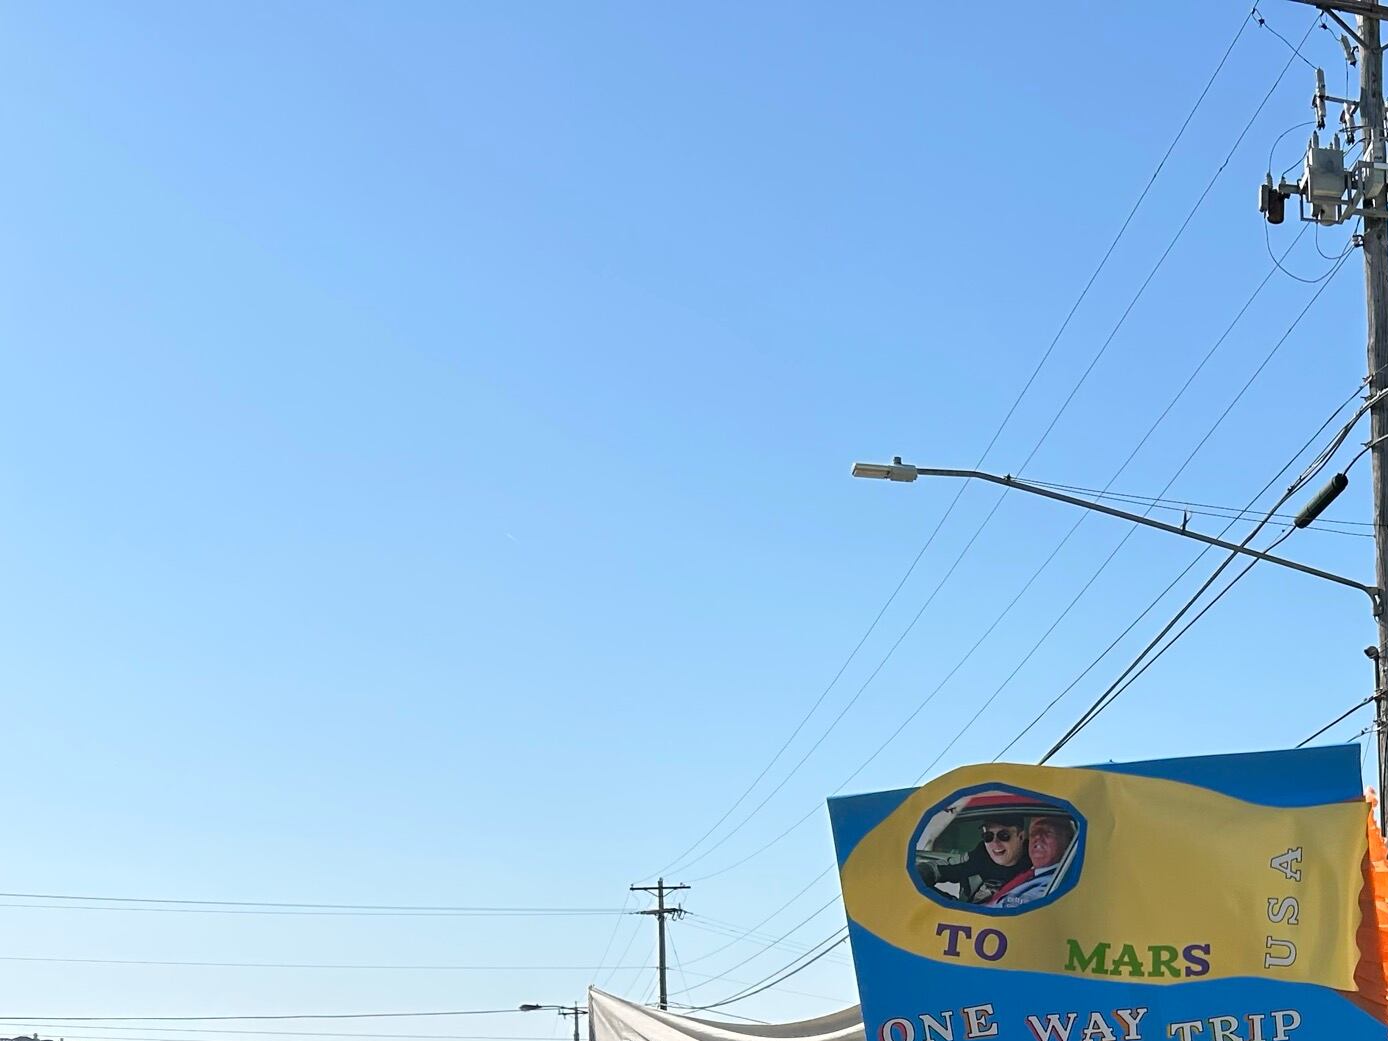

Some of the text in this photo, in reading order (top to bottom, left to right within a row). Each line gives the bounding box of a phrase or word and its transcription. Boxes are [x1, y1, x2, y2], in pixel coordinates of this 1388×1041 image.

[935, 922, 1212, 979] TO MARS
[1264, 846, 1303, 969] USA
